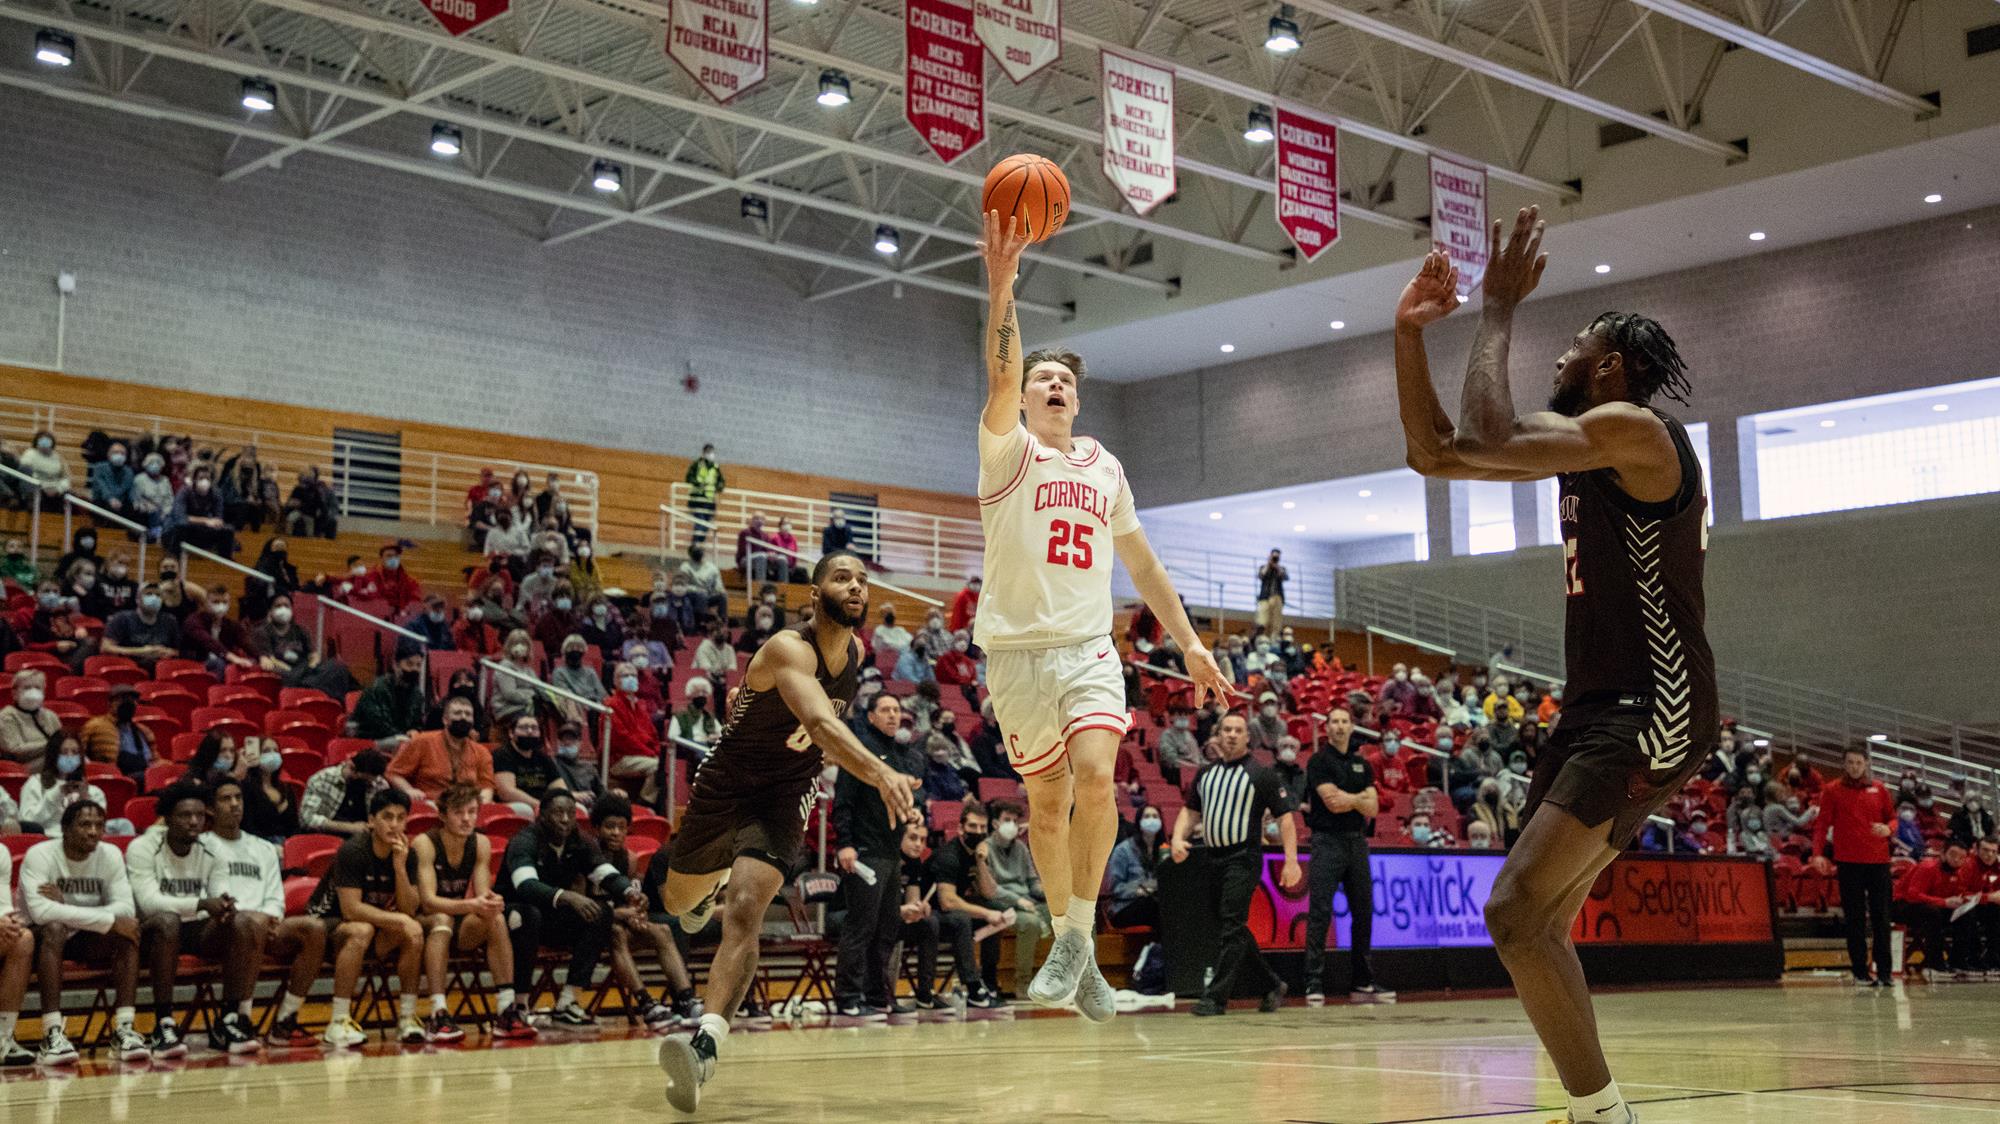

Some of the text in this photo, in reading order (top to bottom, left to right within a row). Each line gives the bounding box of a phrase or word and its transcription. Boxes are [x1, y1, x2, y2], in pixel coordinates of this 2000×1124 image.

[430, 0, 477, 21] 2008
[686, 0, 758, 19] ETBALL
[976, 2, 1056, 40] SWEET SIXTEEN
[703, 15, 738, 40] NCAA
[909, 6, 981, 47] CORNELL
[674, 25, 762, 65] TOURNAMENT
[927, 42, 964, 67] MEN'S
[701, 66, 738, 90] 2008
[910, 54, 982, 89] BASKETBALL
[912, 74, 980, 106] IVY LEAGUE
[1104, 69, 1169, 104] CORNELL
[911, 93, 980, 130] CHAMPIONS
[1125, 103, 1153, 123] MEN'S
[1126, 138, 1152, 158] NCAA
[1280, 122, 1334, 155] CORNELL
[1287, 150, 1328, 174] WOMEN'S
[1280, 164, 1335, 192] BASKETBALL
[1434, 170, 1482, 199] CORNELL
[1282, 181, 1333, 208] IVY LEAGUE
[1281, 197, 1335, 229] CHAMPIONS
[1437, 208, 1483, 232] BASKETBALL
[1450, 231, 1470, 248] NCAA
[1034, 480, 1109, 528] CORNELL
[1047, 519, 1094, 570] 25
[1009, 733, 1025, 760] C
[1334, 858, 1480, 930] dgwick
[1624, 864, 1747, 928] Sedgwick
